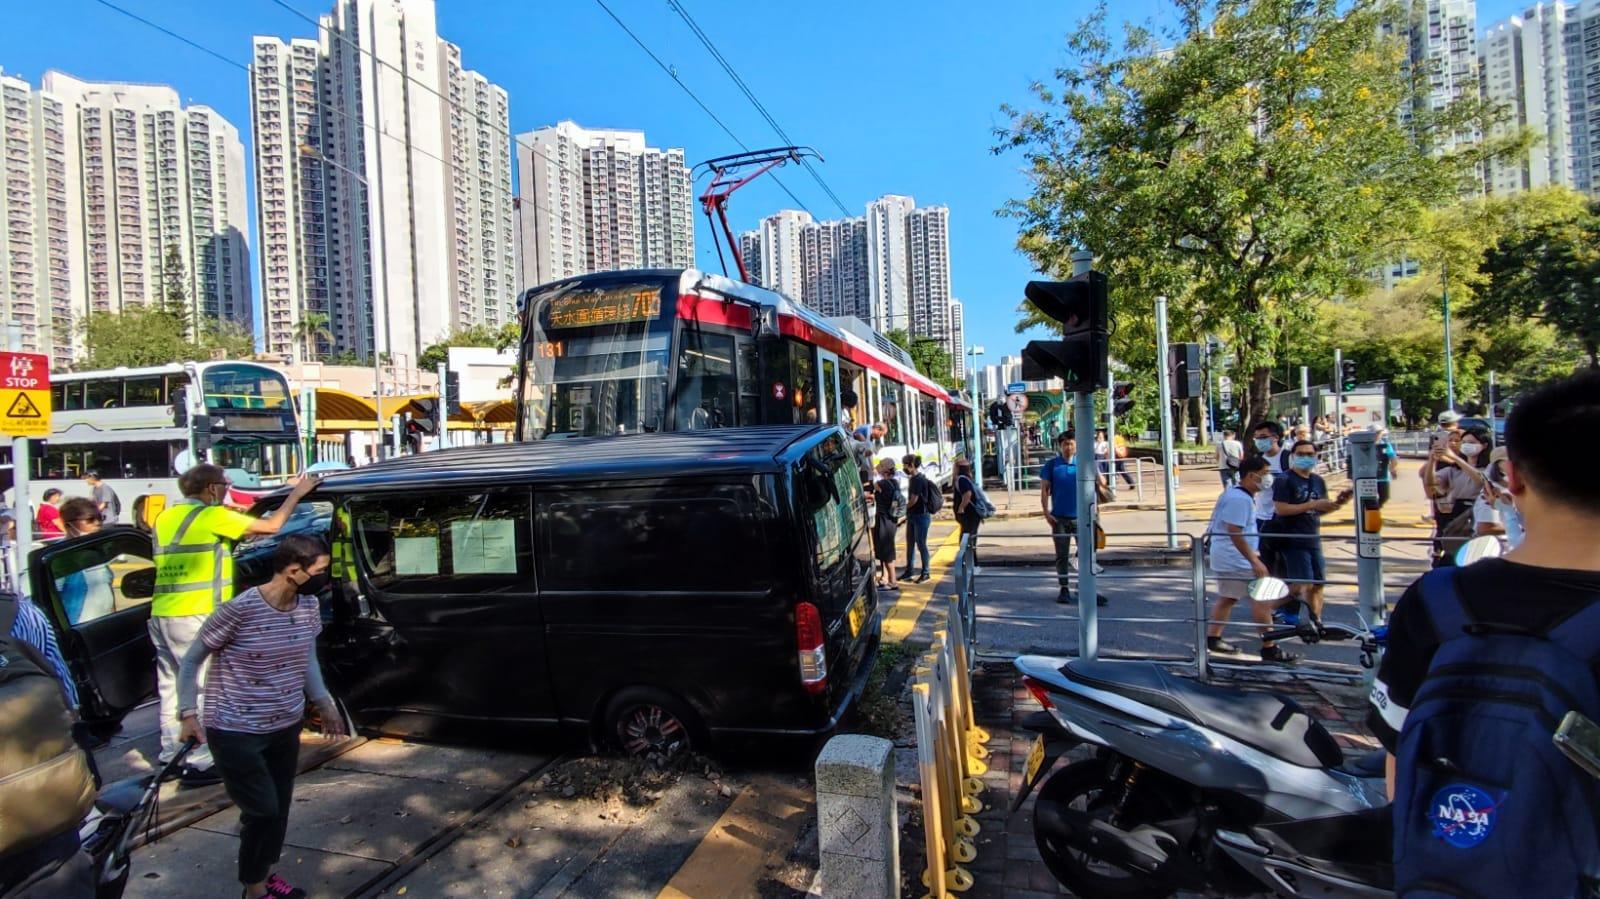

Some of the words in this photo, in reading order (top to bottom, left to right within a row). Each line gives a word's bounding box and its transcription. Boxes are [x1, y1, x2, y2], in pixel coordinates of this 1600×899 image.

[538, 341, 563, 358] 131
[10, 356, 34, 377] 停
[6, 377, 38, 388] STOP
[1439, 804, 1489, 826] NASA
